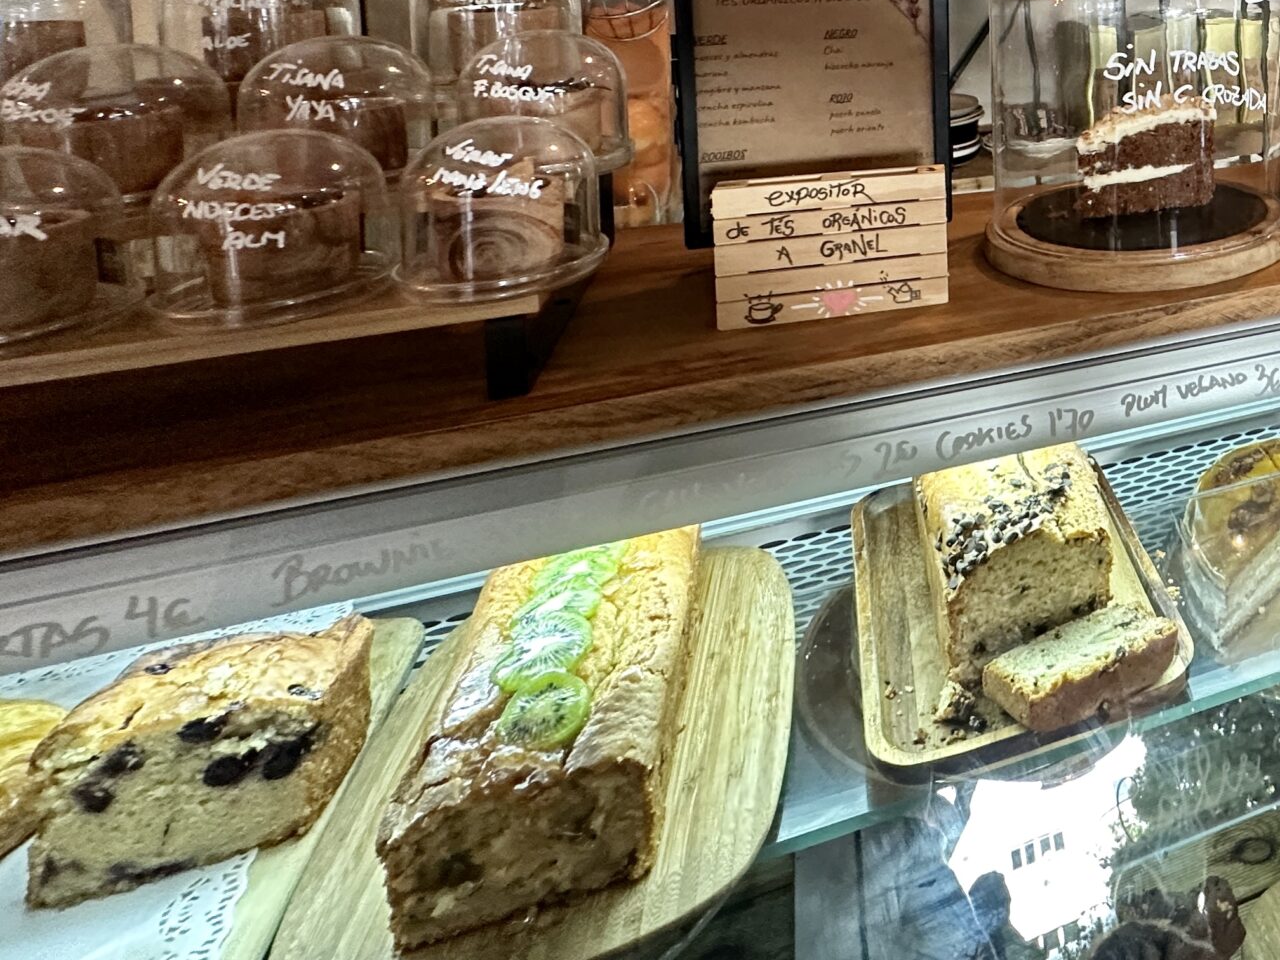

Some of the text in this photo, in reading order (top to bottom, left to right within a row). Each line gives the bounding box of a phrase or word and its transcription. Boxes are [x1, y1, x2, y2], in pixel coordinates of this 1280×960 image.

[1103, 43, 1156, 81] SIN
[1121, 81, 1162, 114] SIN
[776, 232, 888, 265] A GRANEL
